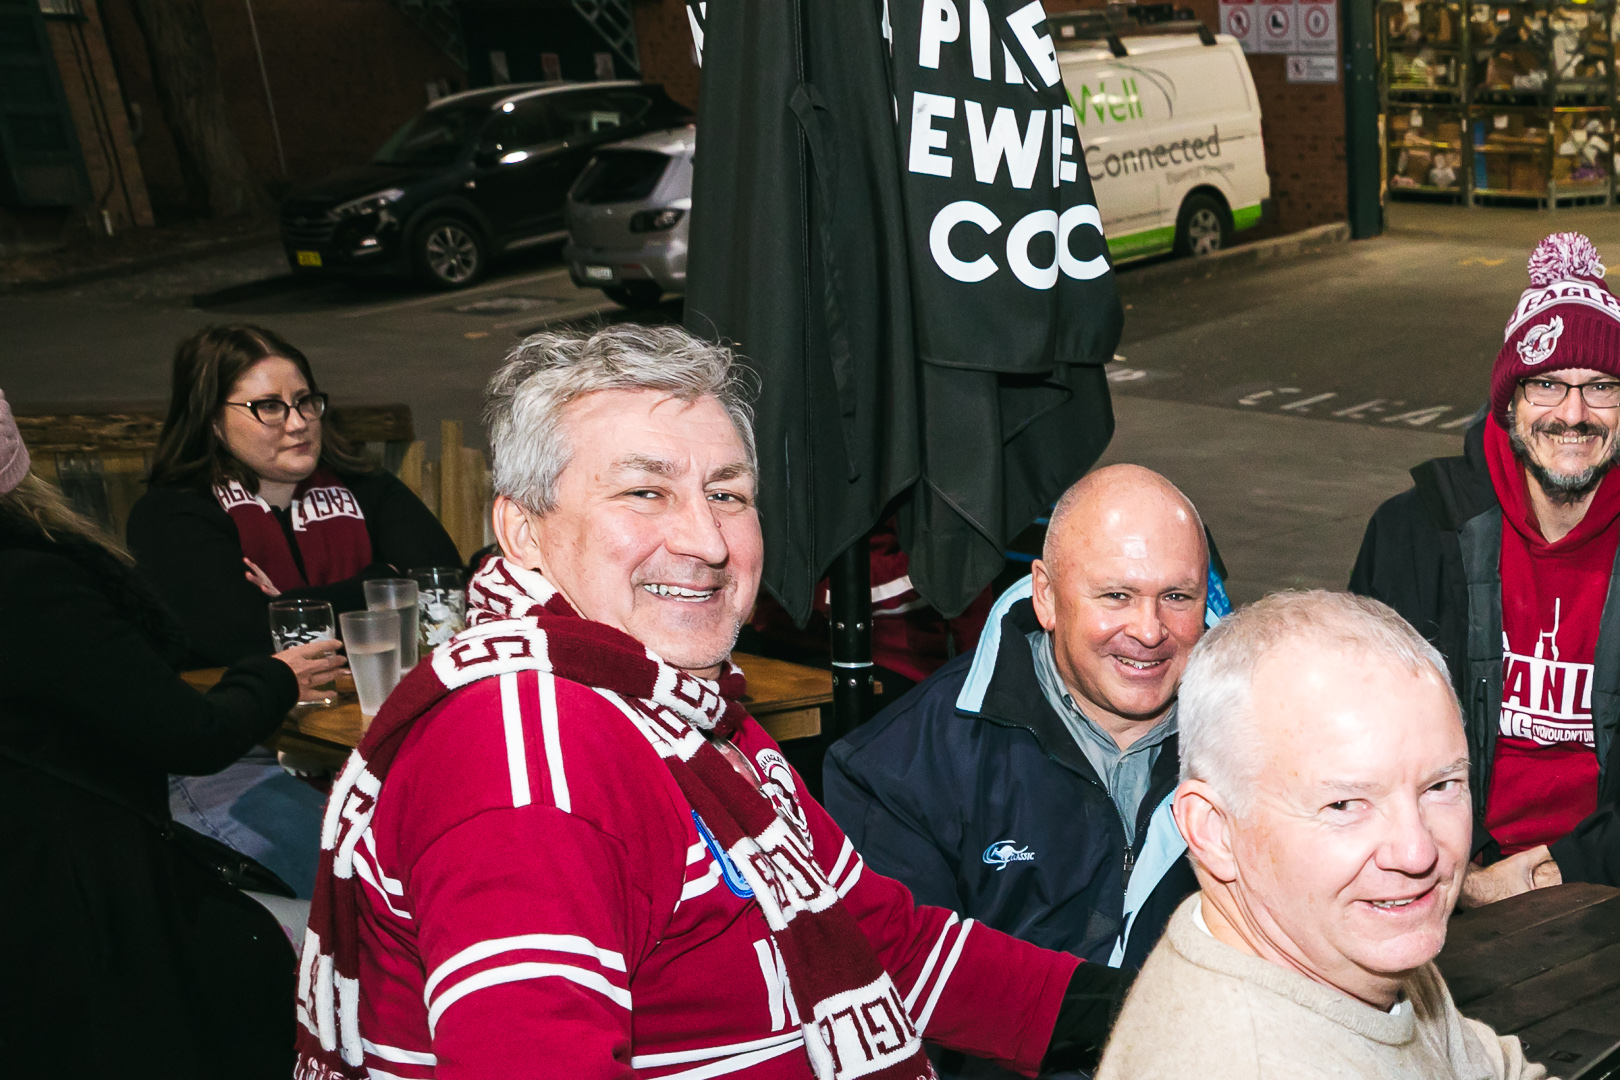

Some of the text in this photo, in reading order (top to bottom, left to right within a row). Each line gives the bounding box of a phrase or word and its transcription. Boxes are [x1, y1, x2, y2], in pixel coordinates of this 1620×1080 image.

[1066, 78, 1143, 126] Well
[1085, 125, 1221, 181] Connected
[1502, 657, 1592, 715] ANL
